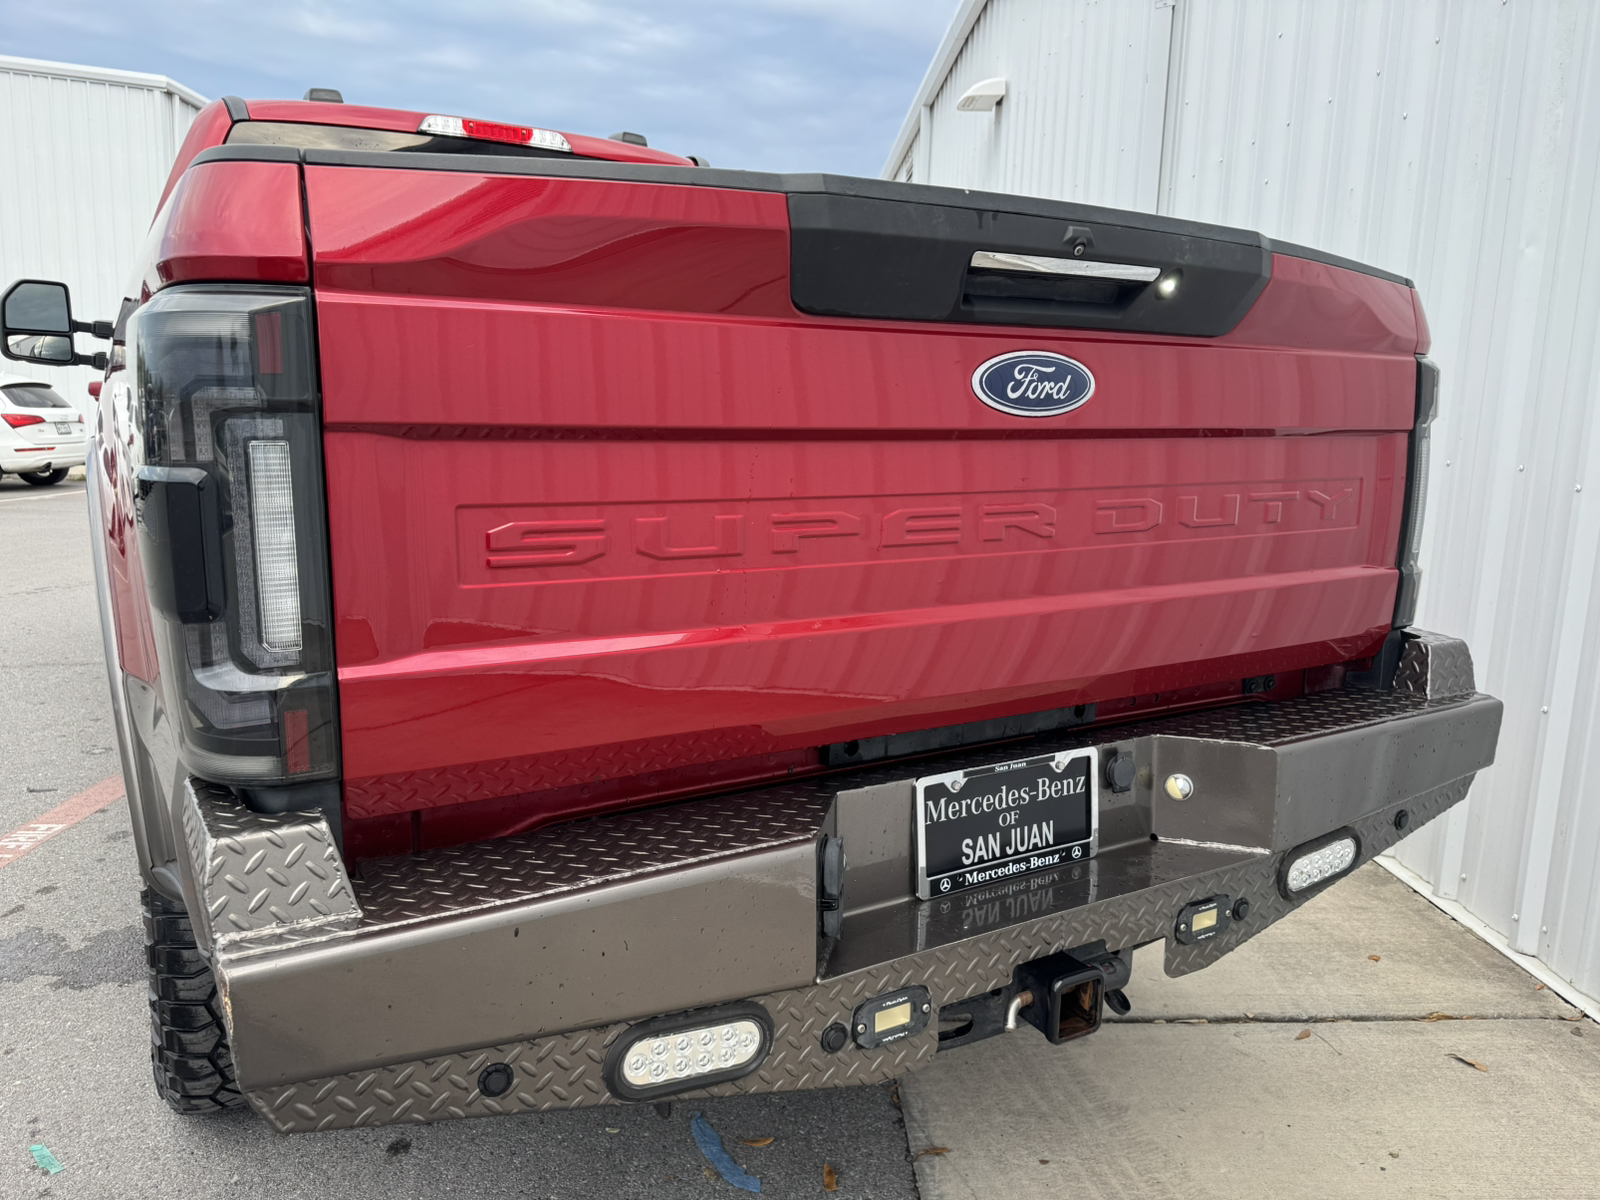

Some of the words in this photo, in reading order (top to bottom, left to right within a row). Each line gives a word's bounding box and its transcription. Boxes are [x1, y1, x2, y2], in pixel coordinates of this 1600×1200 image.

[1007, 364, 1072, 400] Ford
[485, 502, 1058, 569] SUPER
[1095, 487, 1354, 535] DUTY
[994, 765, 1008, 773] San
[1009, 762, 1027, 771] Juan
[925, 775, 1086, 825] Mercedes-Benz
[999, 810, 1020, 827] OF
[961, 832, 1000, 865] SAN
[1006, 820, 1054, 855] JUAN
[964, 853, 1060, 886] Mercedes-Benz
